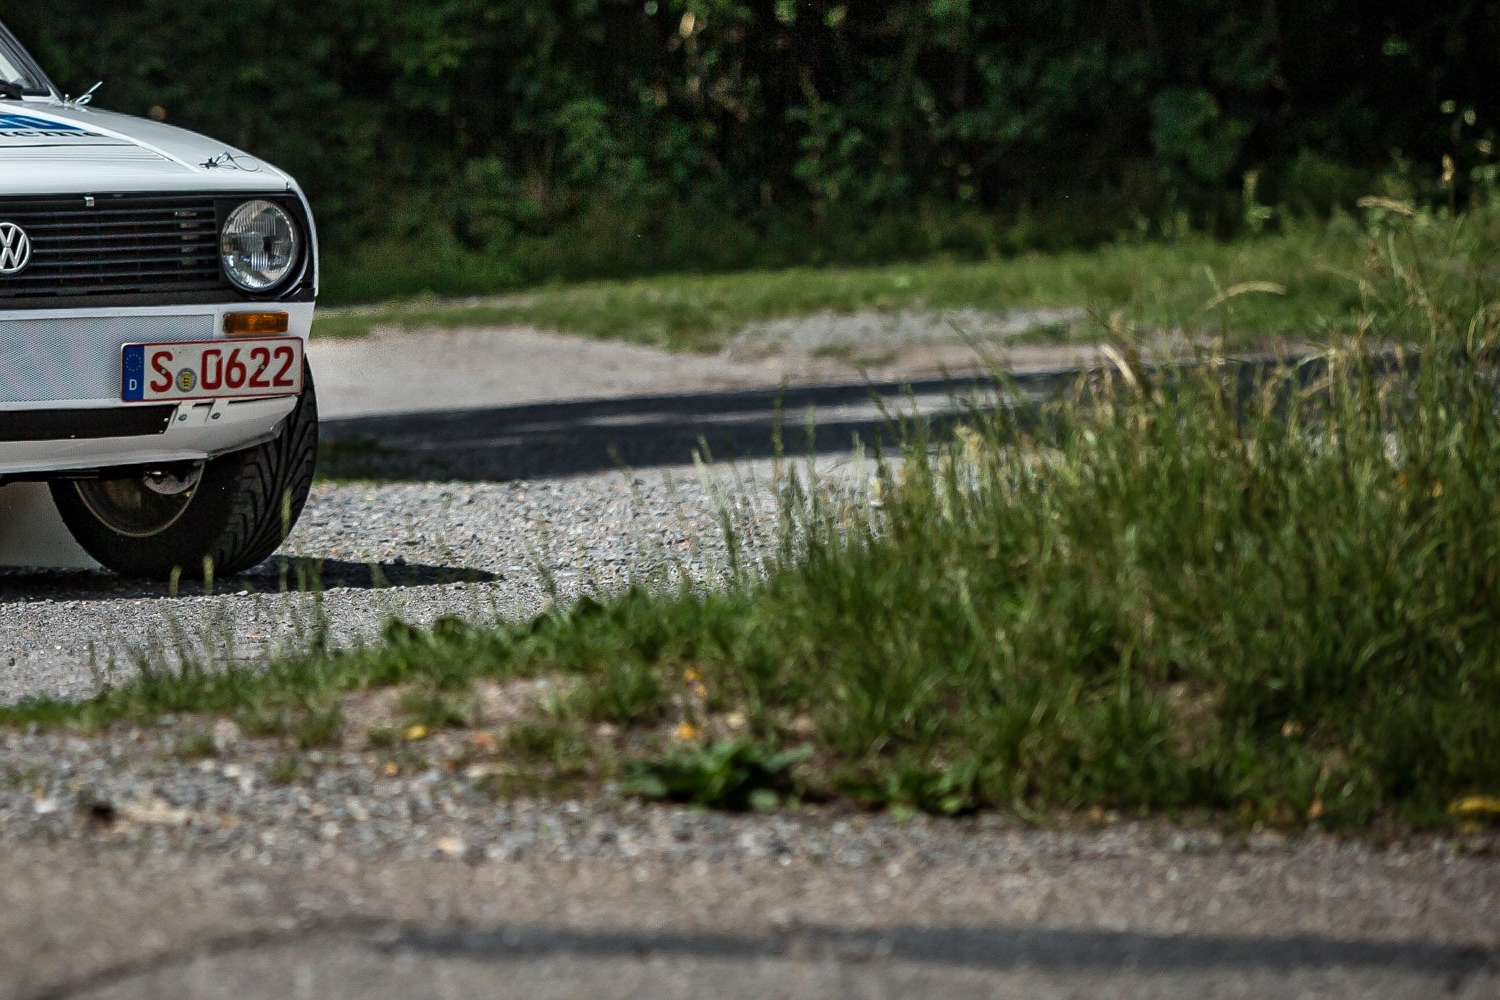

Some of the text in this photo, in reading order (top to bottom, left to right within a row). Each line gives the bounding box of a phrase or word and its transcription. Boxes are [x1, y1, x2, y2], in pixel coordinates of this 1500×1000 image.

[128, 345, 295, 393] D S 0622
